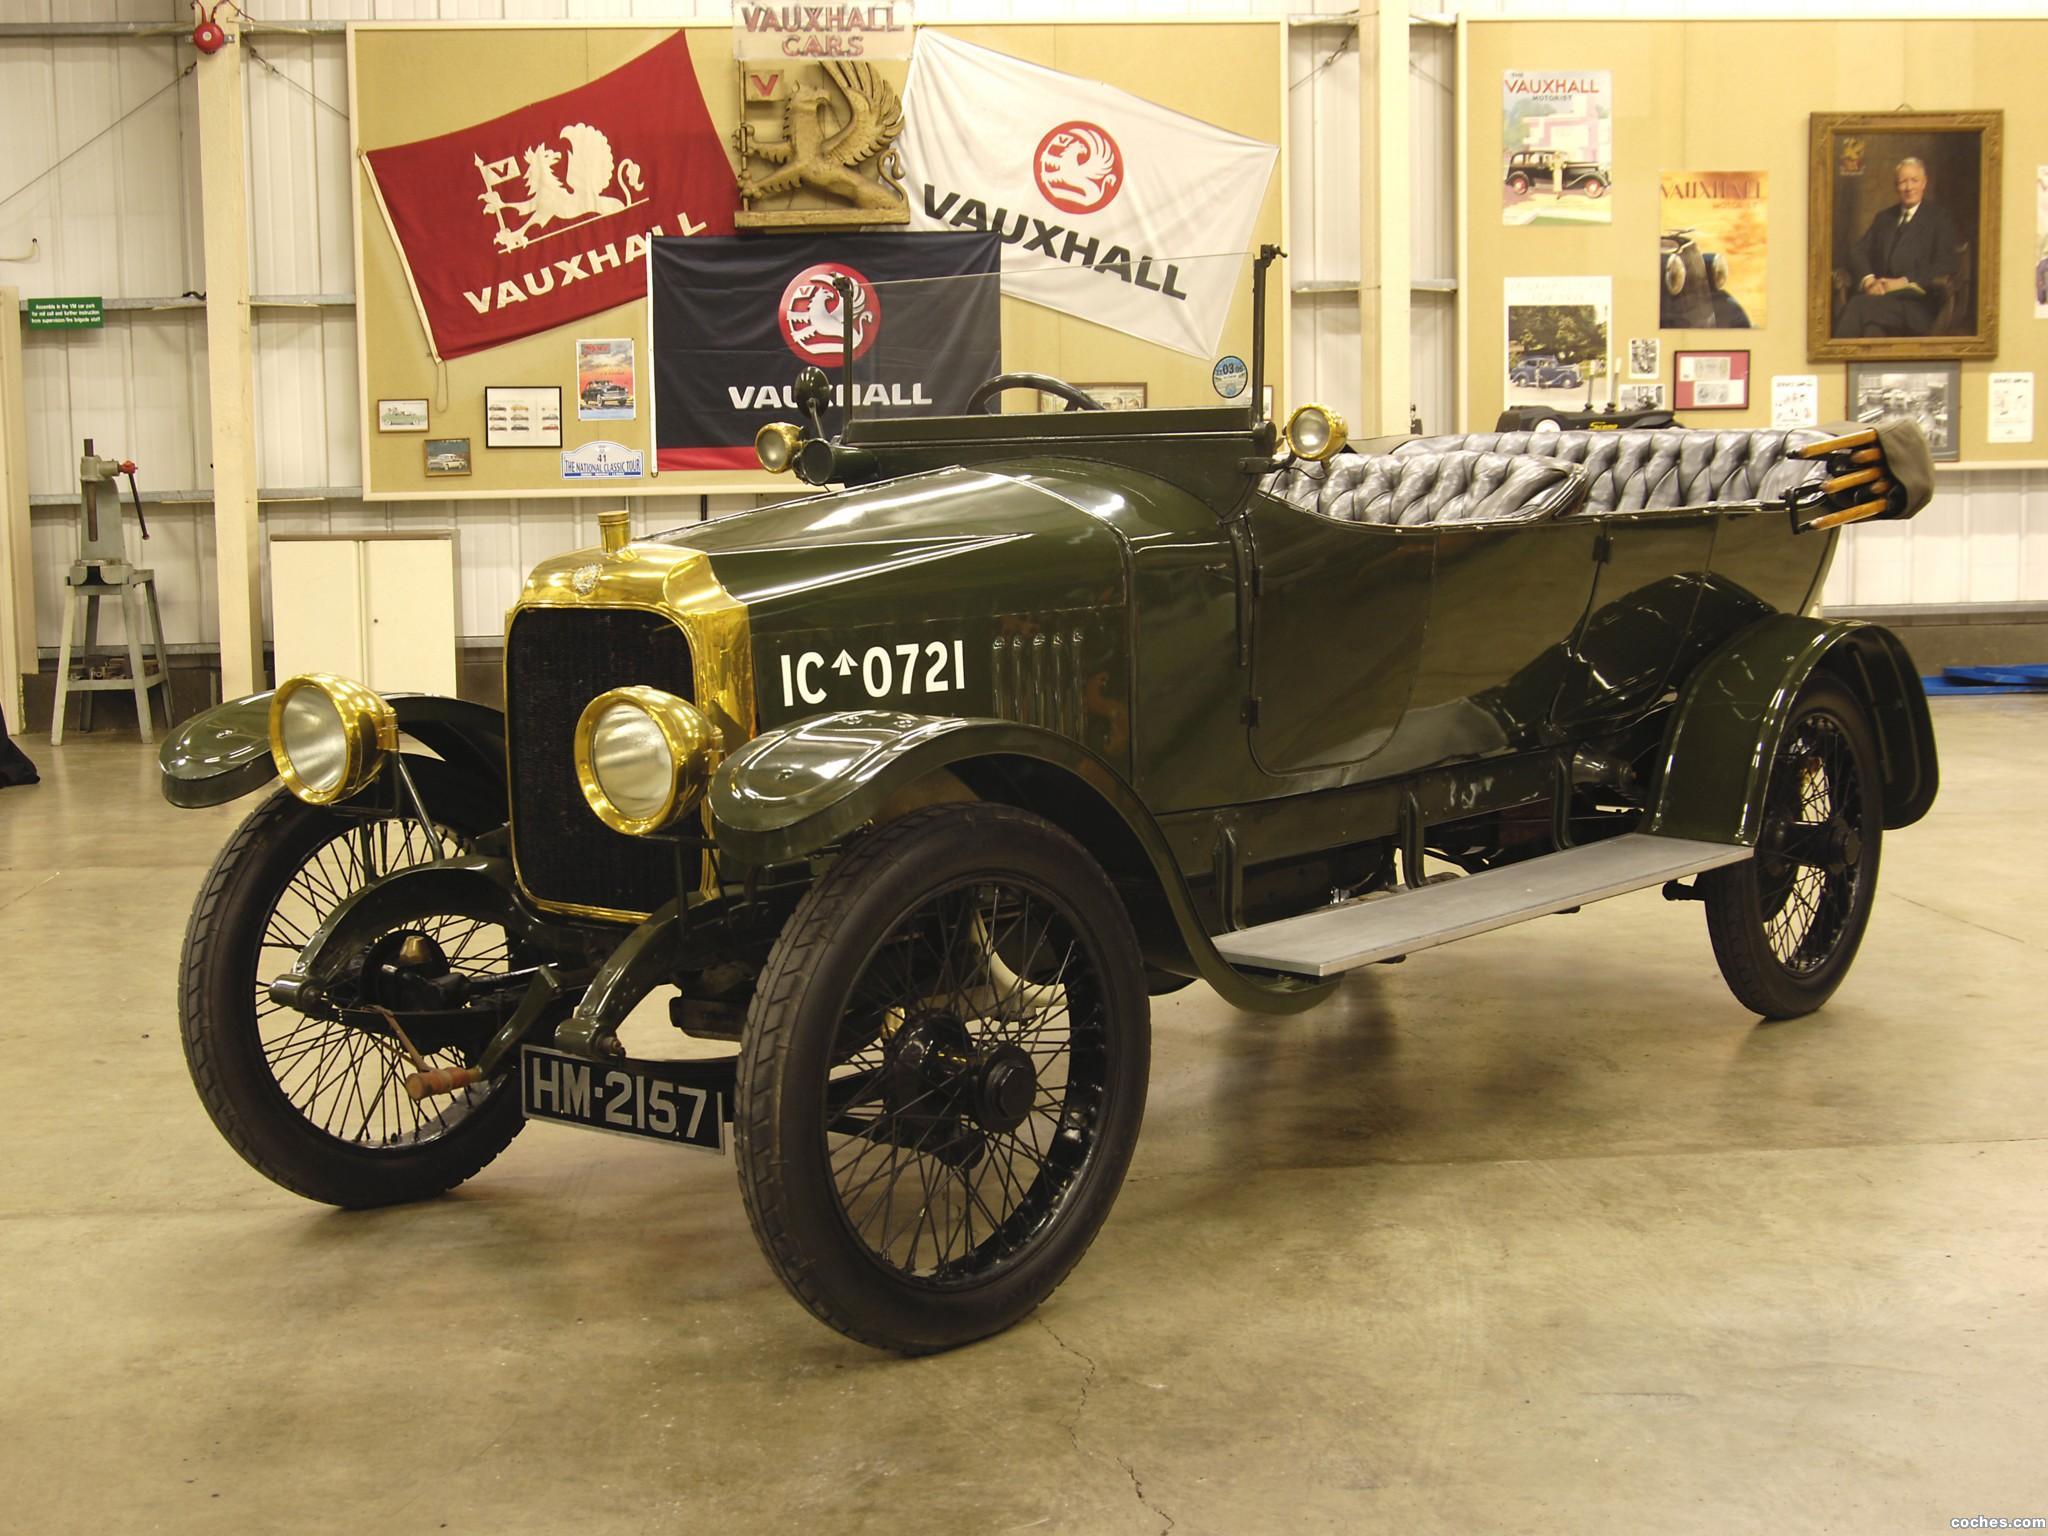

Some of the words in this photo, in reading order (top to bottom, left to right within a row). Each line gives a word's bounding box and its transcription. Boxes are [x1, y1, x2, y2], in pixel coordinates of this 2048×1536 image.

[741, 6, 904, 33] VAUXHALL
[782, 35, 864, 57] CARS
[751, 74, 779, 97] V
[1505, 79, 1600, 94] VAUXHALL
[489, 161, 510, 177] V
[924, 184, 1187, 301] VAUXHALL
[565, 460, 575, 472] THE
[576, 462, 602, 472] NATIONAL
[604, 461, 625, 472] CLASSIC
[626, 458, 641, 471] TOUR
[597, 454, 607, 462] 41
[863, 639, 965, 698] 0721
